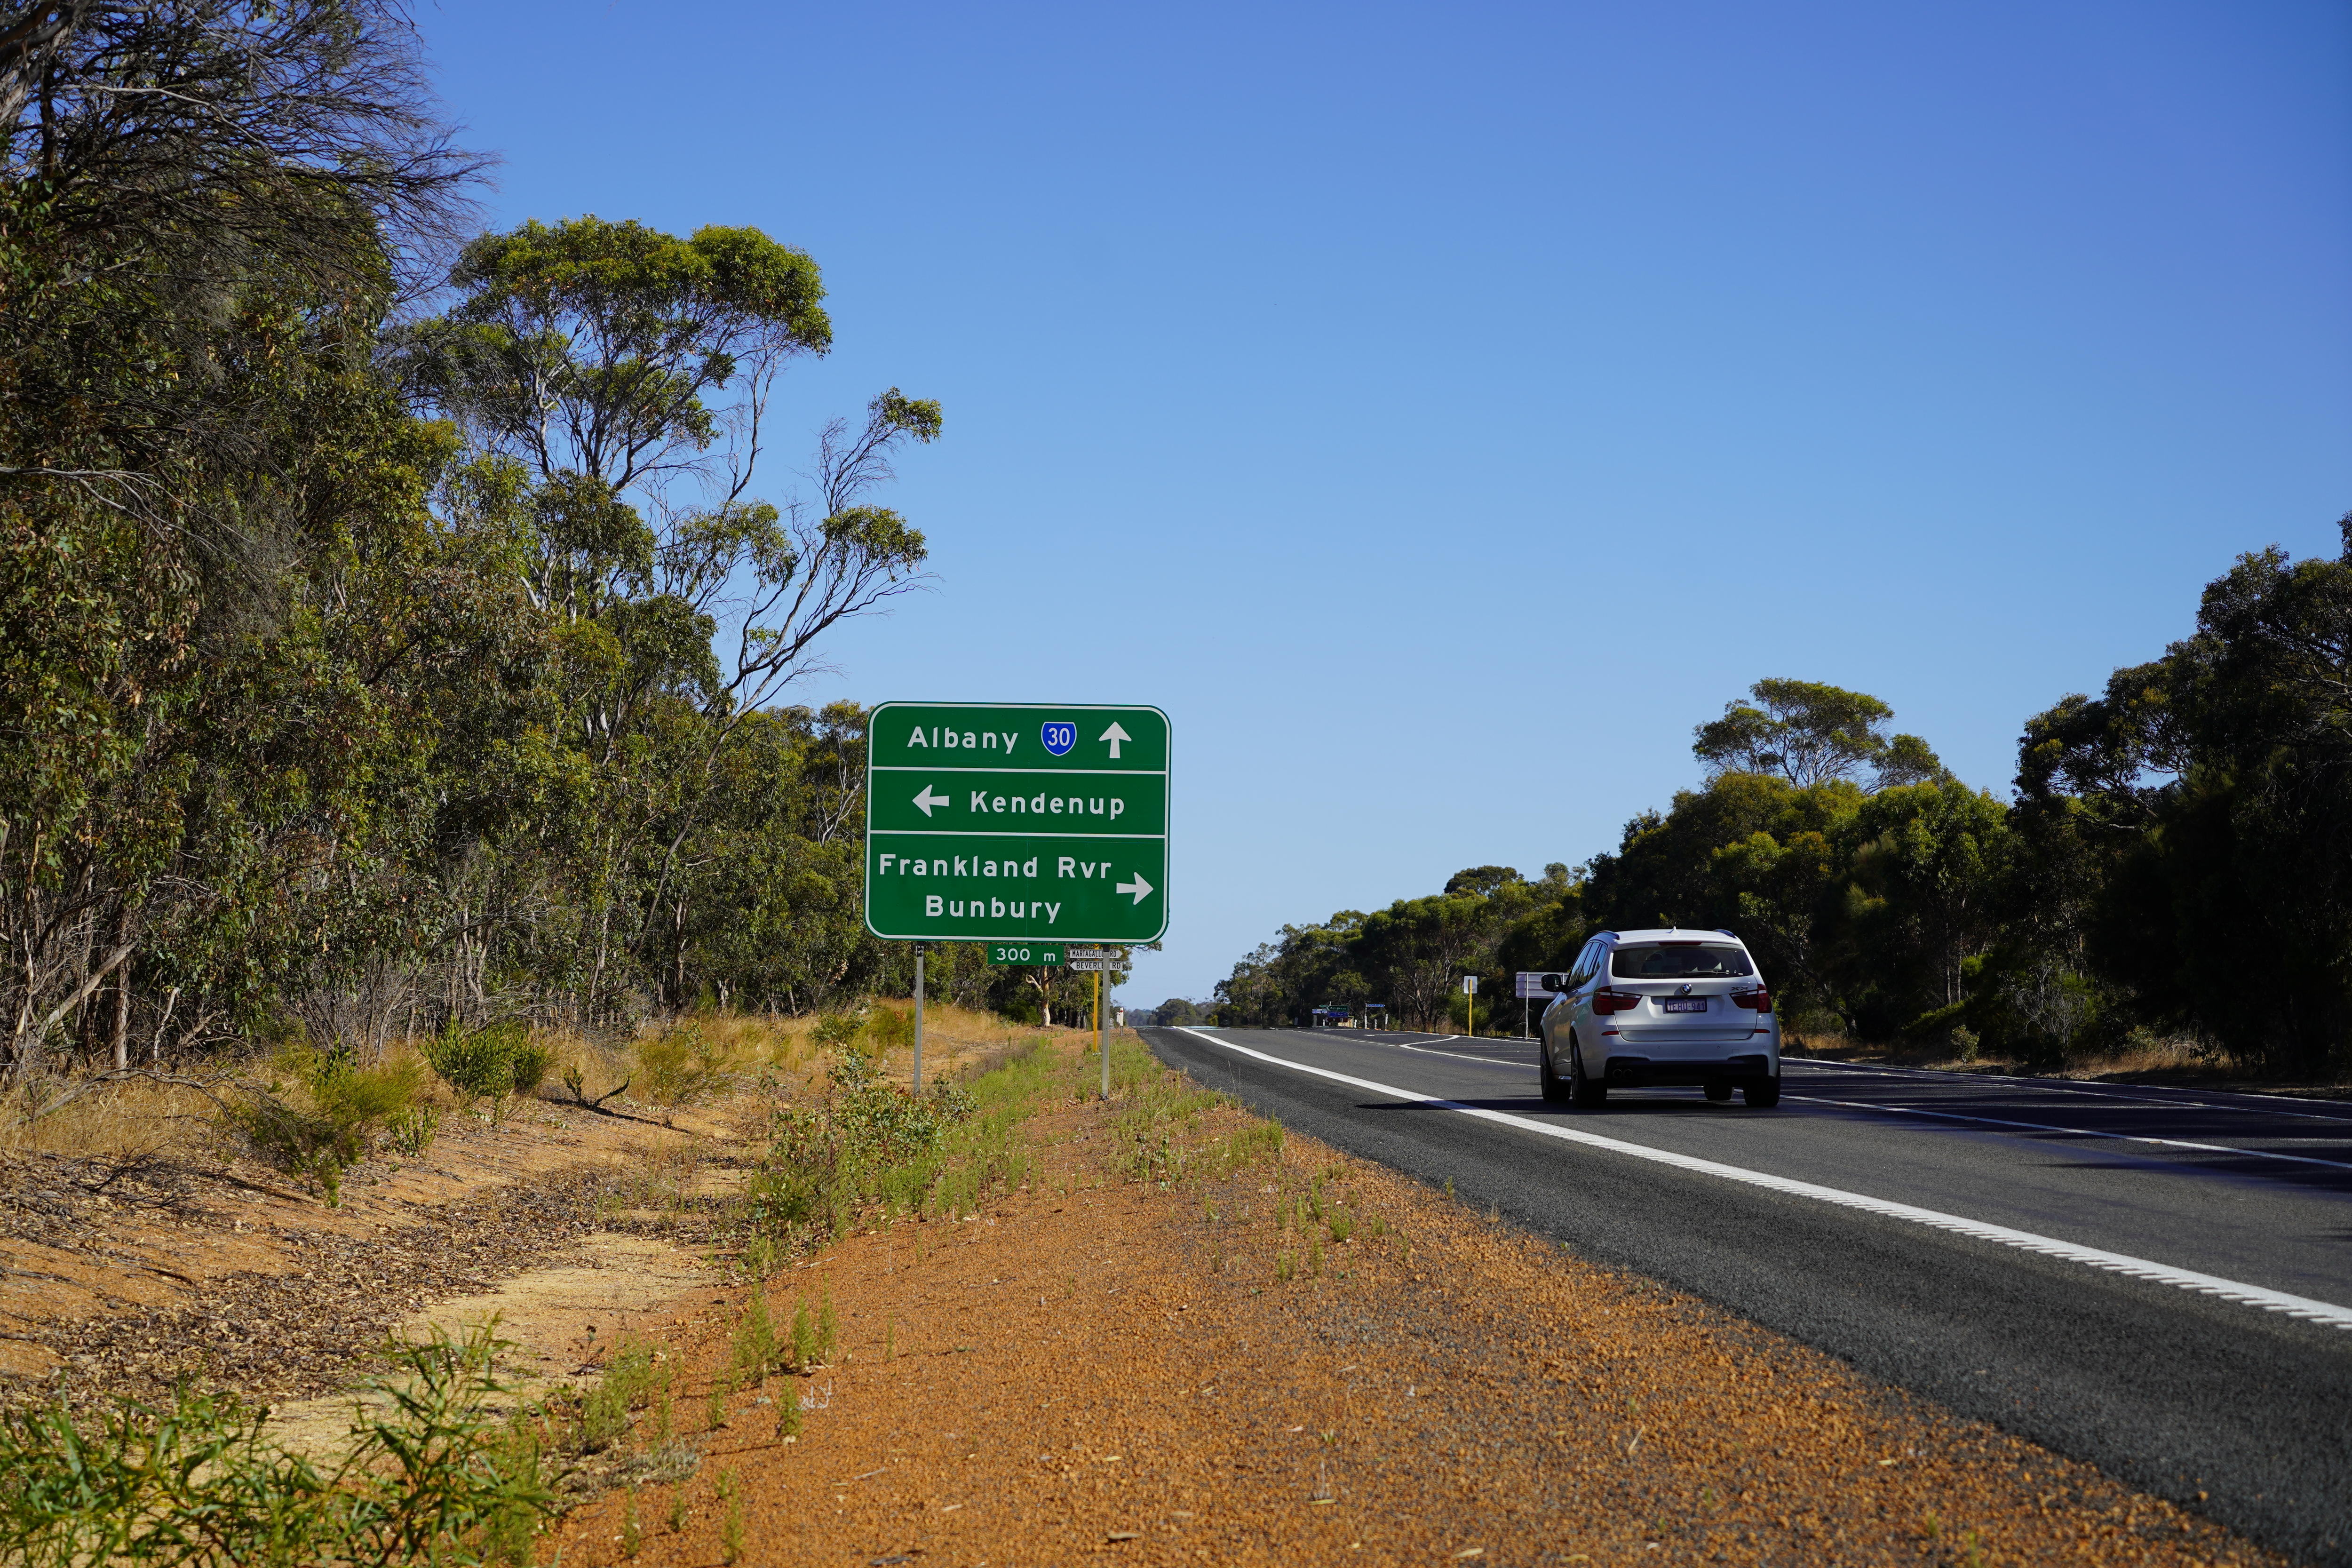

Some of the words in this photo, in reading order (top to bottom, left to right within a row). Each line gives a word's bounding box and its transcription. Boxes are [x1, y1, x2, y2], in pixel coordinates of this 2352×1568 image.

[907, 726, 1018, 754] Albany
[1048, 728, 1070, 746] 30
[971, 791, 1124, 820] Kendenup
[880, 853, 1037, 877] Frankland
[1058, 857, 1112, 878] Rvr
[926, 895, 1061, 923] Bunbury
[996, 948, 1030, 961] 300
[1044, 953, 1056, 962] m
